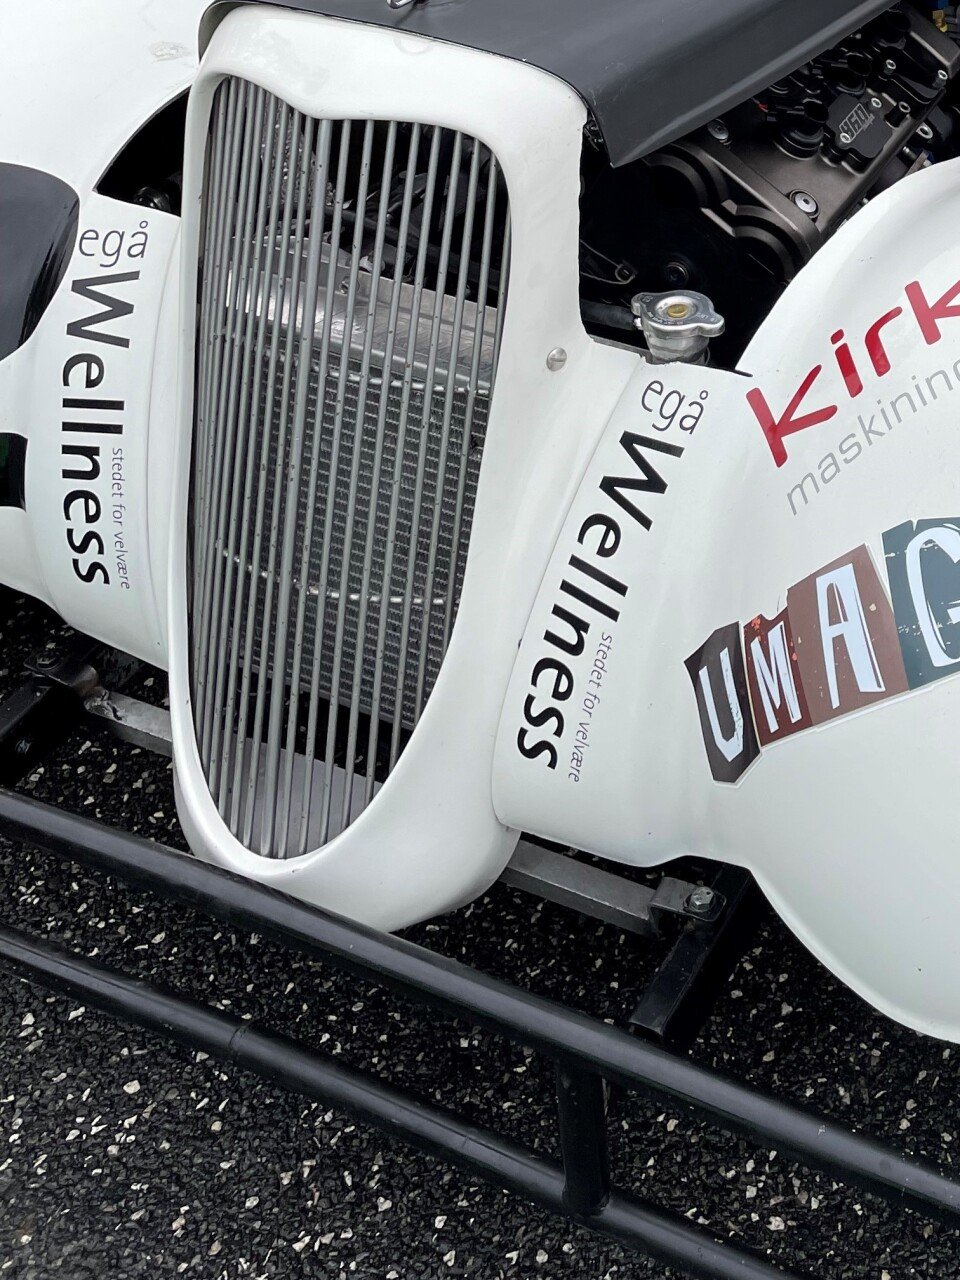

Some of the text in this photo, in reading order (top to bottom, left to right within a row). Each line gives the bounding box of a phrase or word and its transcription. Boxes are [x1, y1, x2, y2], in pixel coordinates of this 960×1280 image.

[78, 221, 148, 268] egå
[61, 270, 140, 587] Wellness
[641, 380, 708, 436] egå
[111, 447, 131, 590] stedet for velvære
[517, 430, 683, 772] Wellness
[568, 632, 613, 782] stedet for velvære
